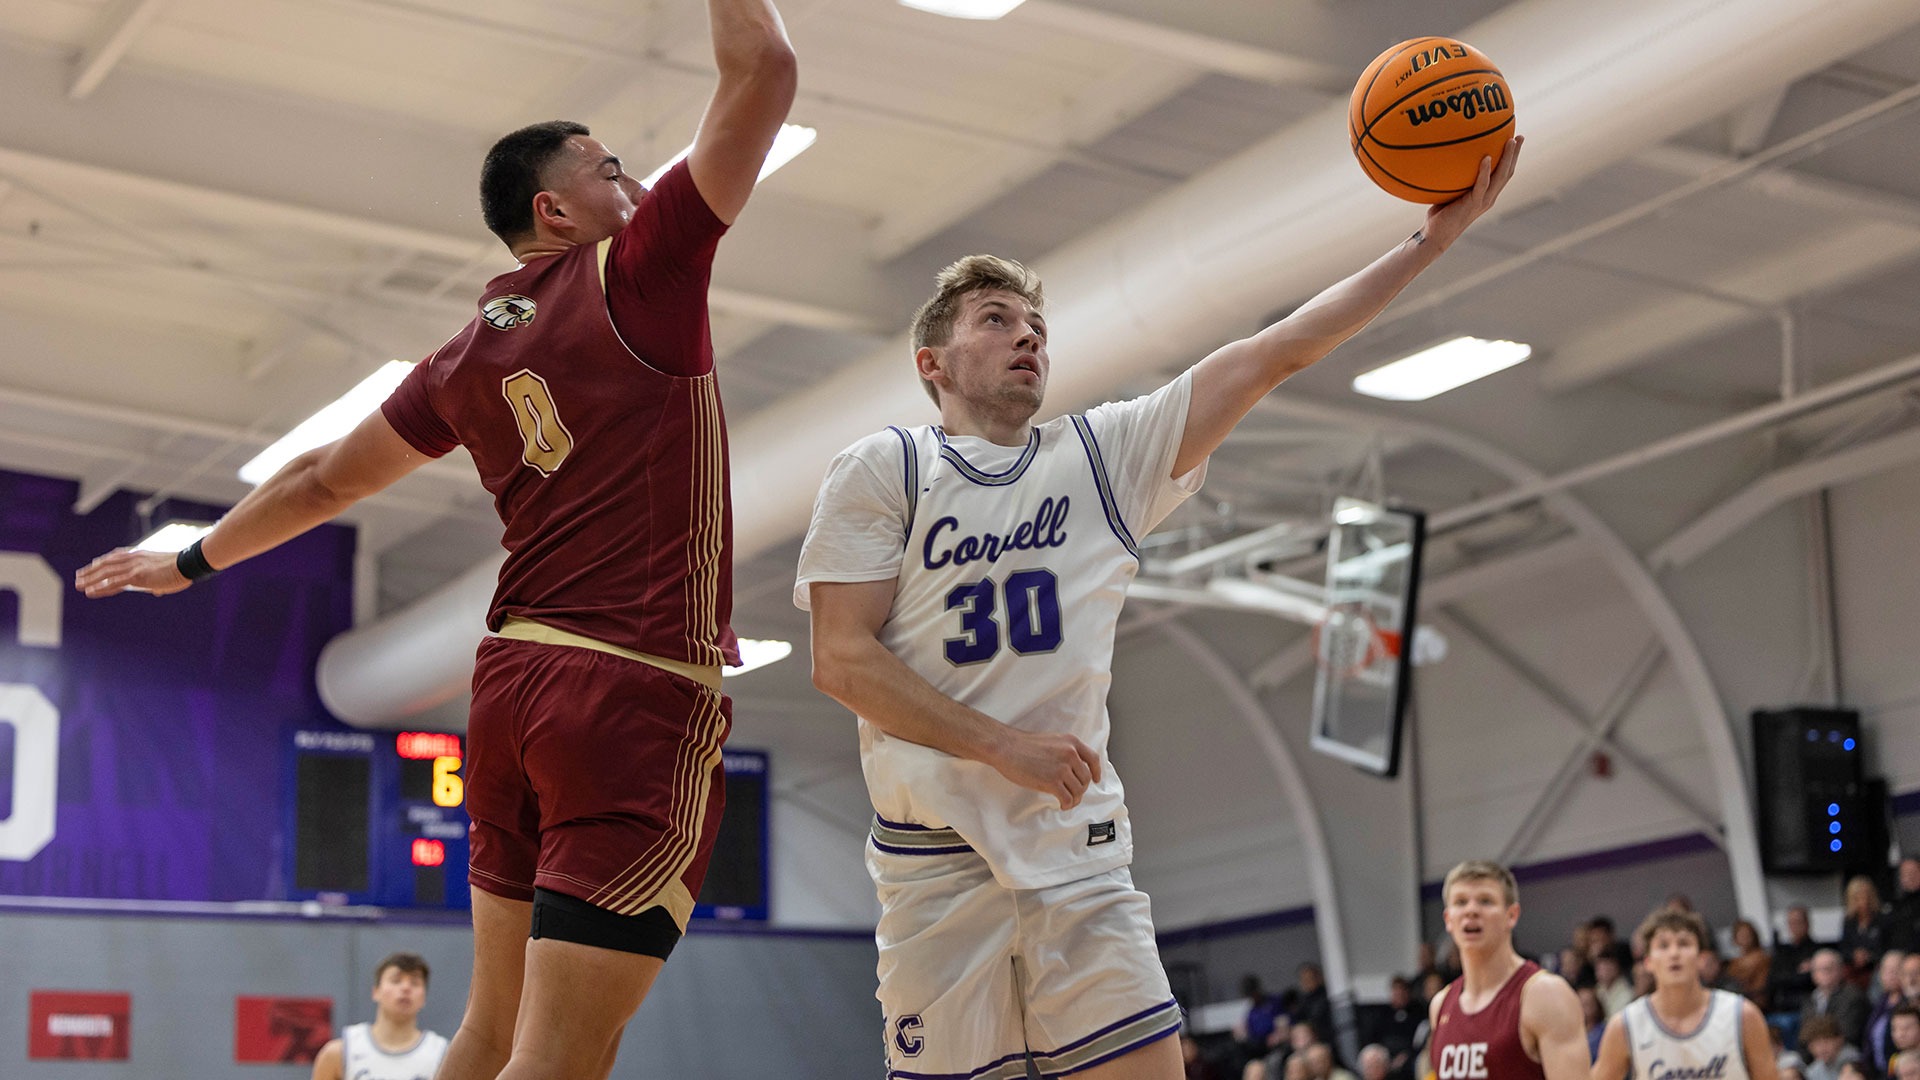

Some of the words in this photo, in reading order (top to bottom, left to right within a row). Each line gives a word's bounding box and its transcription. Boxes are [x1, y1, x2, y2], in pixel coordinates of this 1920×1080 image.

[1411, 44, 1468, 73] EVO
[1407, 82, 1509, 126] Wilson
[502, 368, 574, 478] 0
[943, 567, 1065, 668] 30
[432, 756, 464, 807] 6
[894, 1013, 924, 1058] C
[1439, 1042, 1489, 1079] COE
